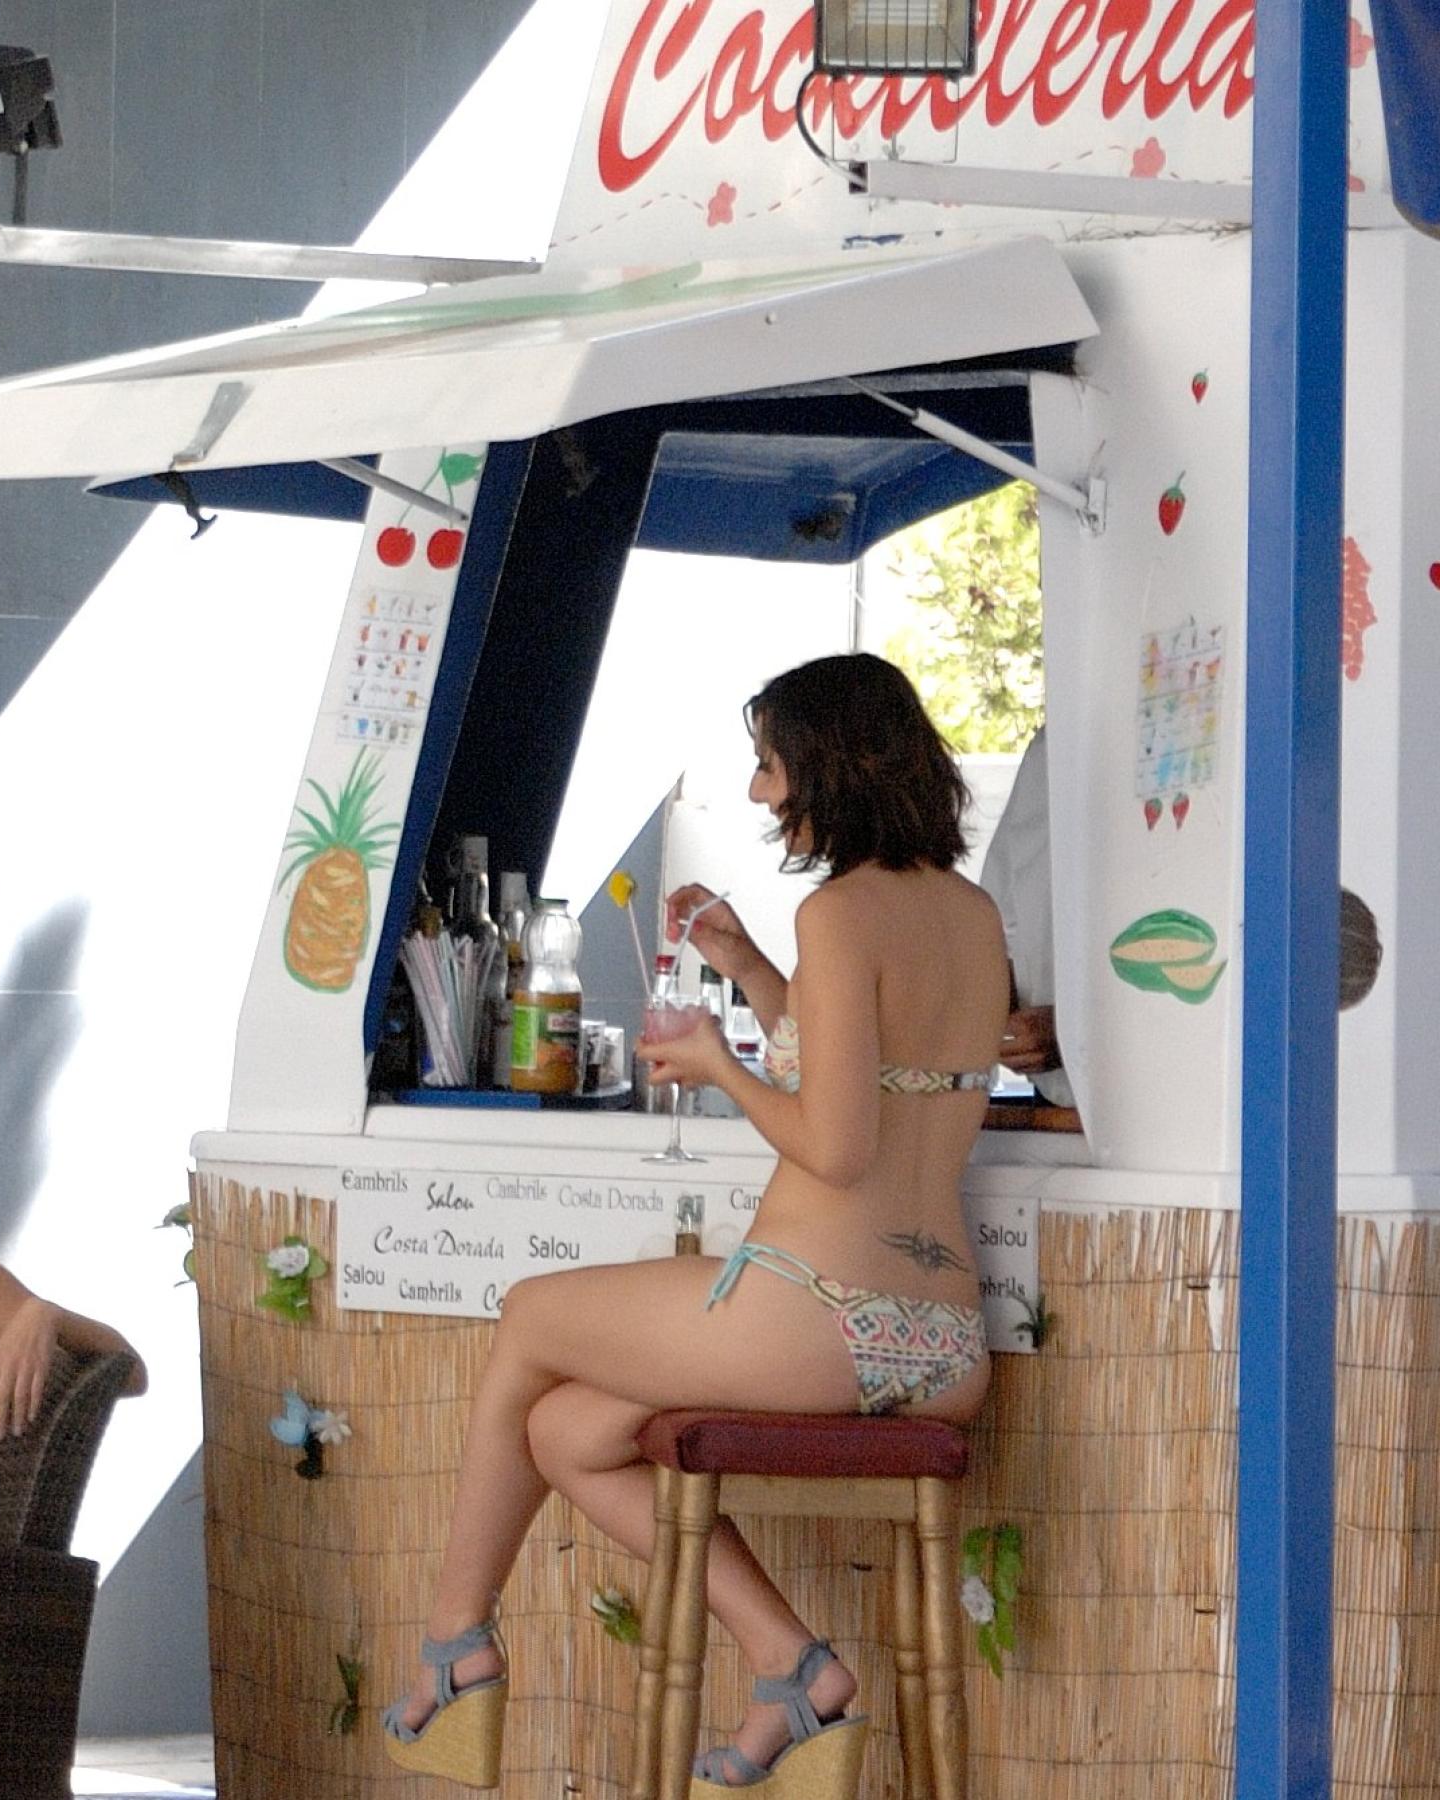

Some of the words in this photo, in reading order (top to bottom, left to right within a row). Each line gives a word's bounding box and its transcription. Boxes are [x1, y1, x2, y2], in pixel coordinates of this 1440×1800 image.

[340, 1169, 408, 1193] Cambrils
[486, 1175, 548, 1201] Cambrils
[426, 1181, 475, 1211] Salou
[558, 1185, 602, 1209] Costa
[607, 1187, 664, 1212] Dorada
[373, 1225, 429, 1256] Costa
[433, 1228, 505, 1260] Dorada
[528, 1234, 581, 1261] Salou
[978, 1223, 1028, 1247] Salou
[343, 1263, 385, 1287] Salou
[398, 1278, 463, 1305] Cambrils
